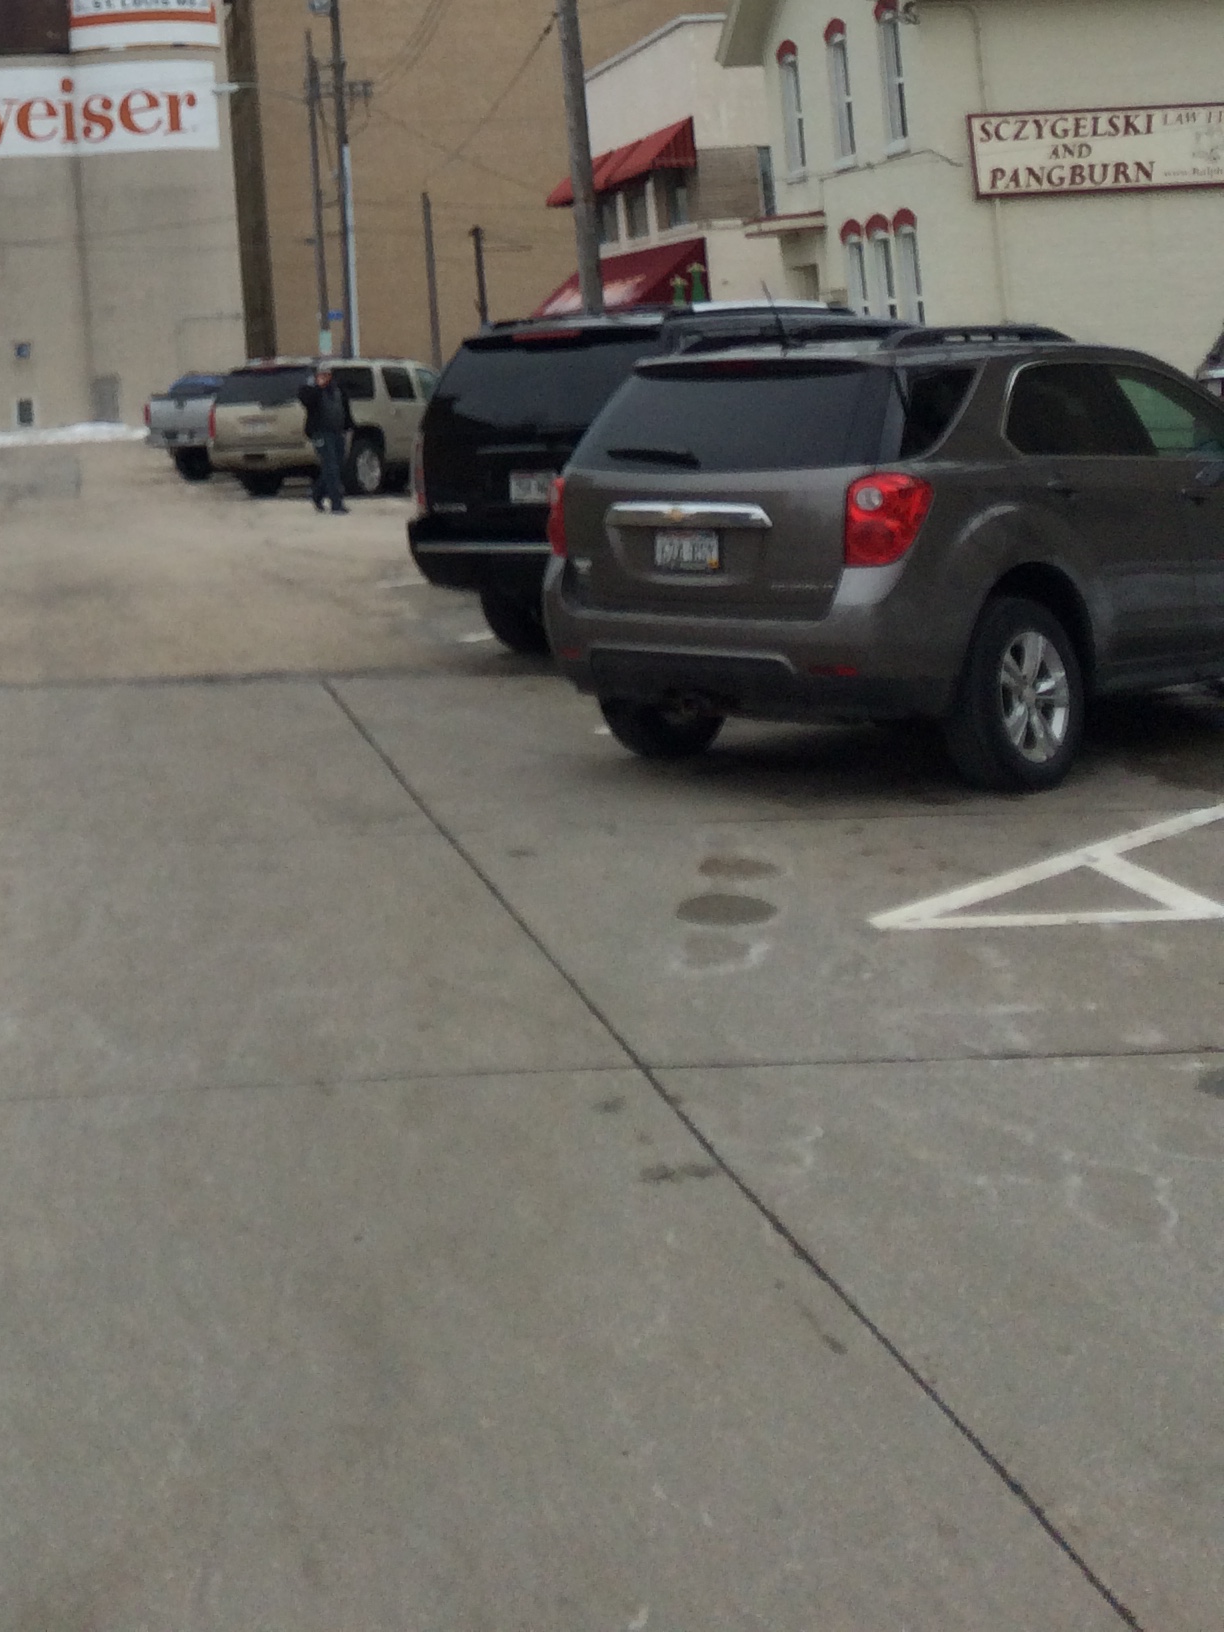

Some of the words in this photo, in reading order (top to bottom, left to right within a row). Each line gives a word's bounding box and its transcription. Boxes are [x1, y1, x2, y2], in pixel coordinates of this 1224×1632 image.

[979, 113, 1155, 142] SCZYGELSKI
[1049, 143, 1093, 159] AND
[989, 161, 1155, 190] PANGBURN
